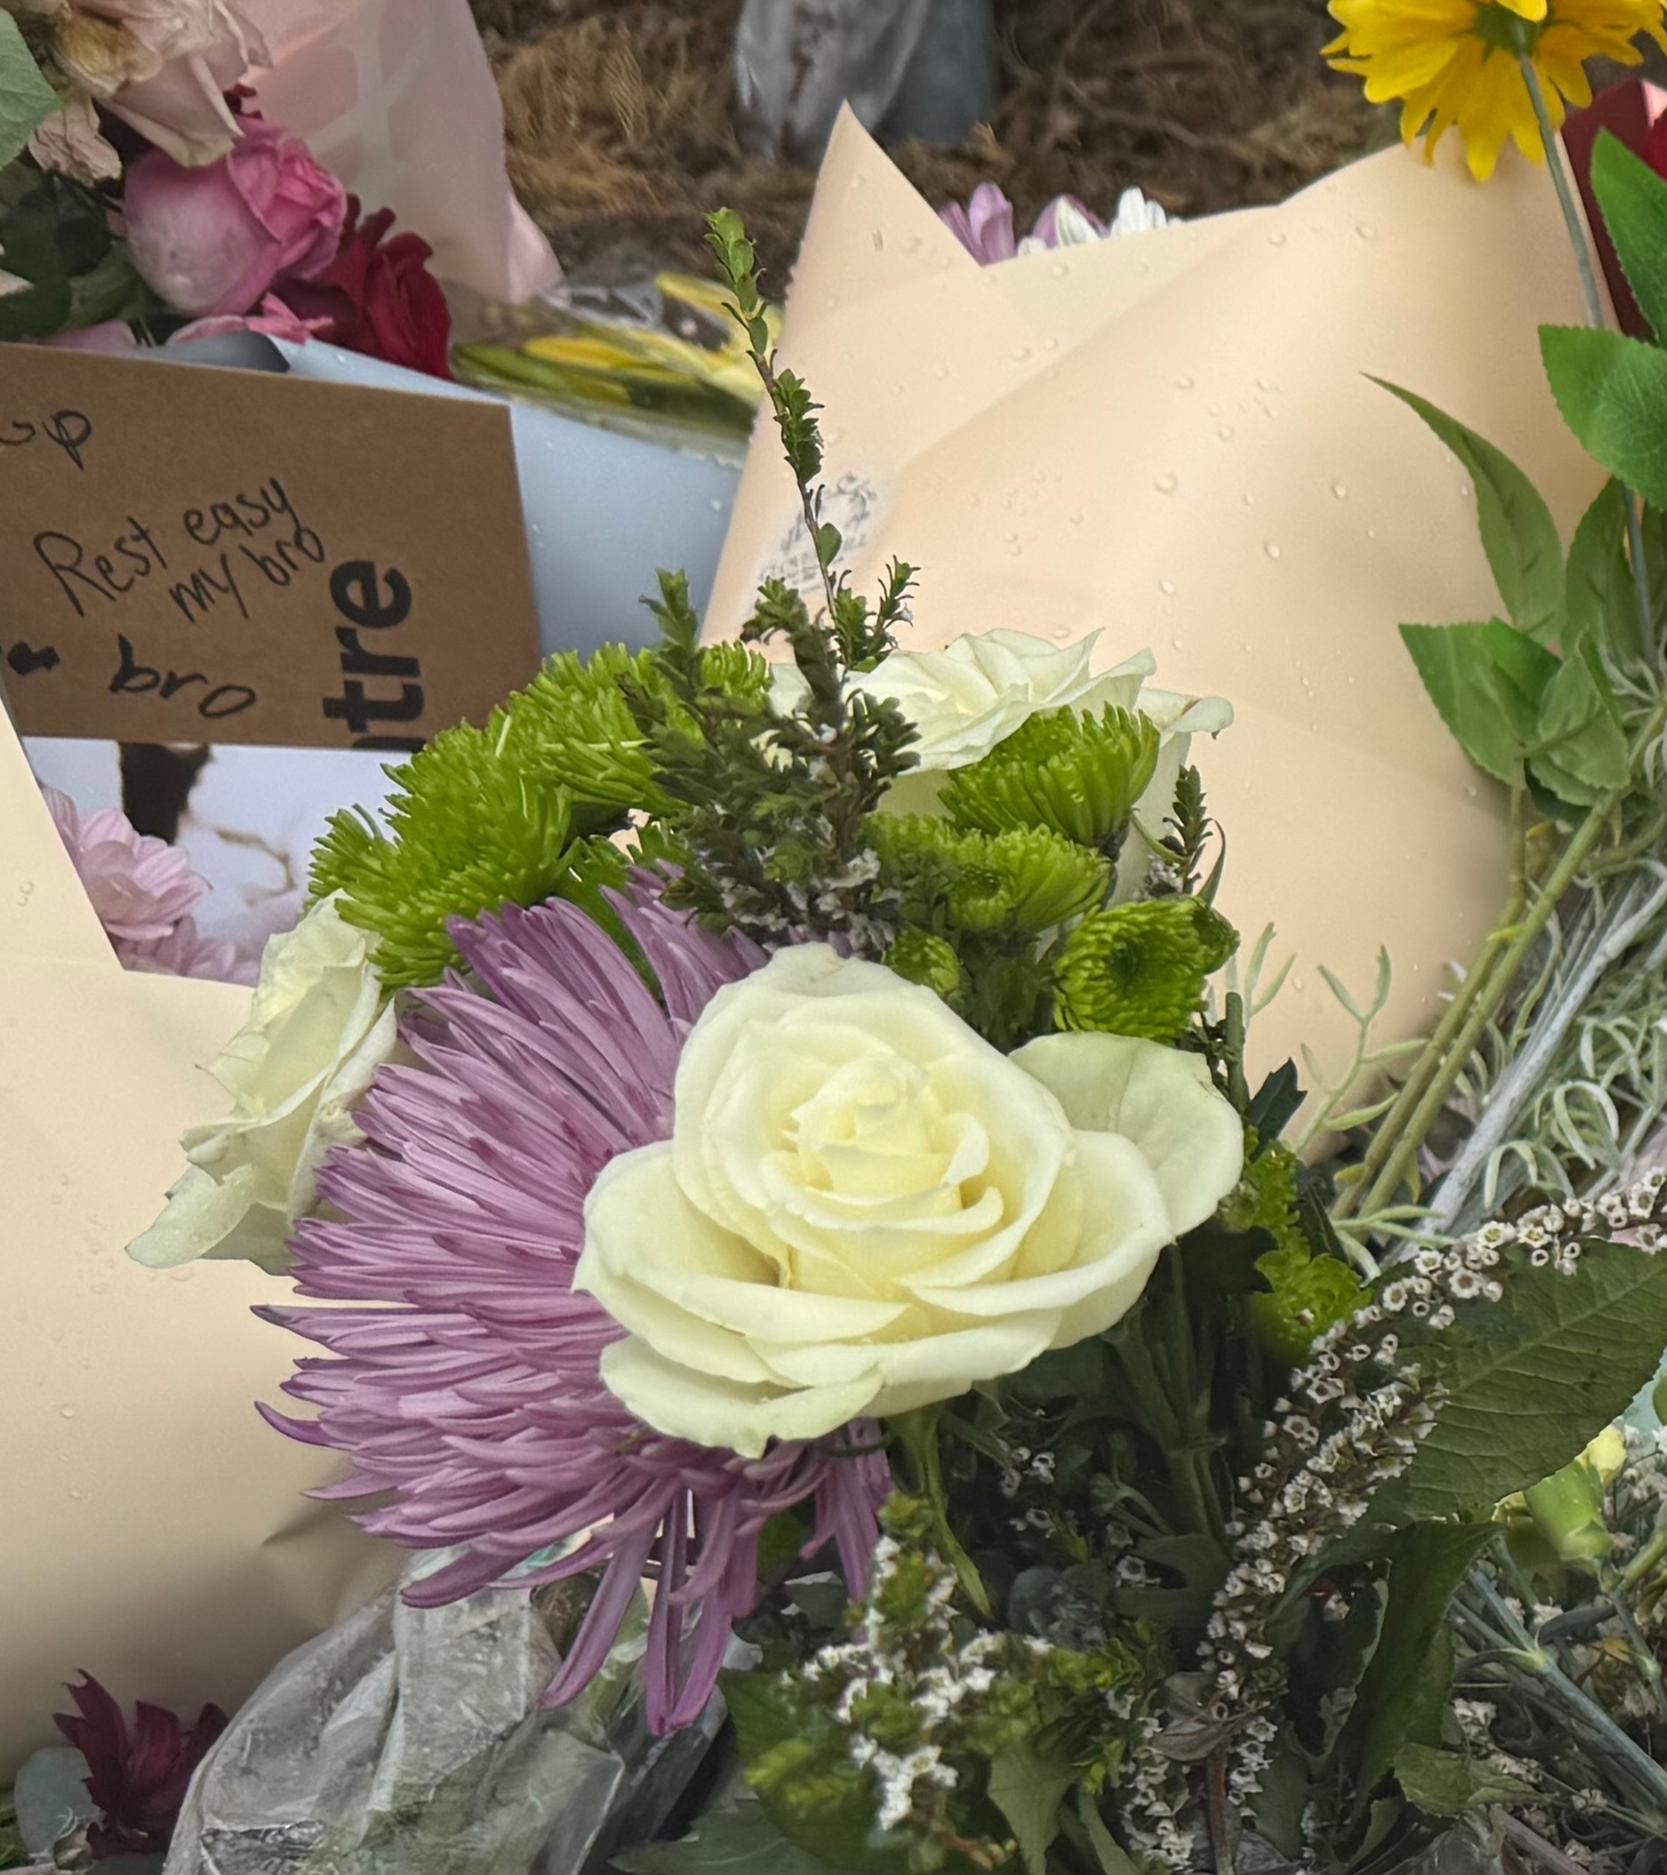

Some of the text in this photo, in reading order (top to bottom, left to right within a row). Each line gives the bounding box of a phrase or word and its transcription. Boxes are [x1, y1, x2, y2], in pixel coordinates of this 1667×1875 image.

[33, 476, 301, 617] Rest easy
[168, 525, 325, 624] my bro
[107, 633, 257, 719] bro
[322, 559, 427, 752] tre
